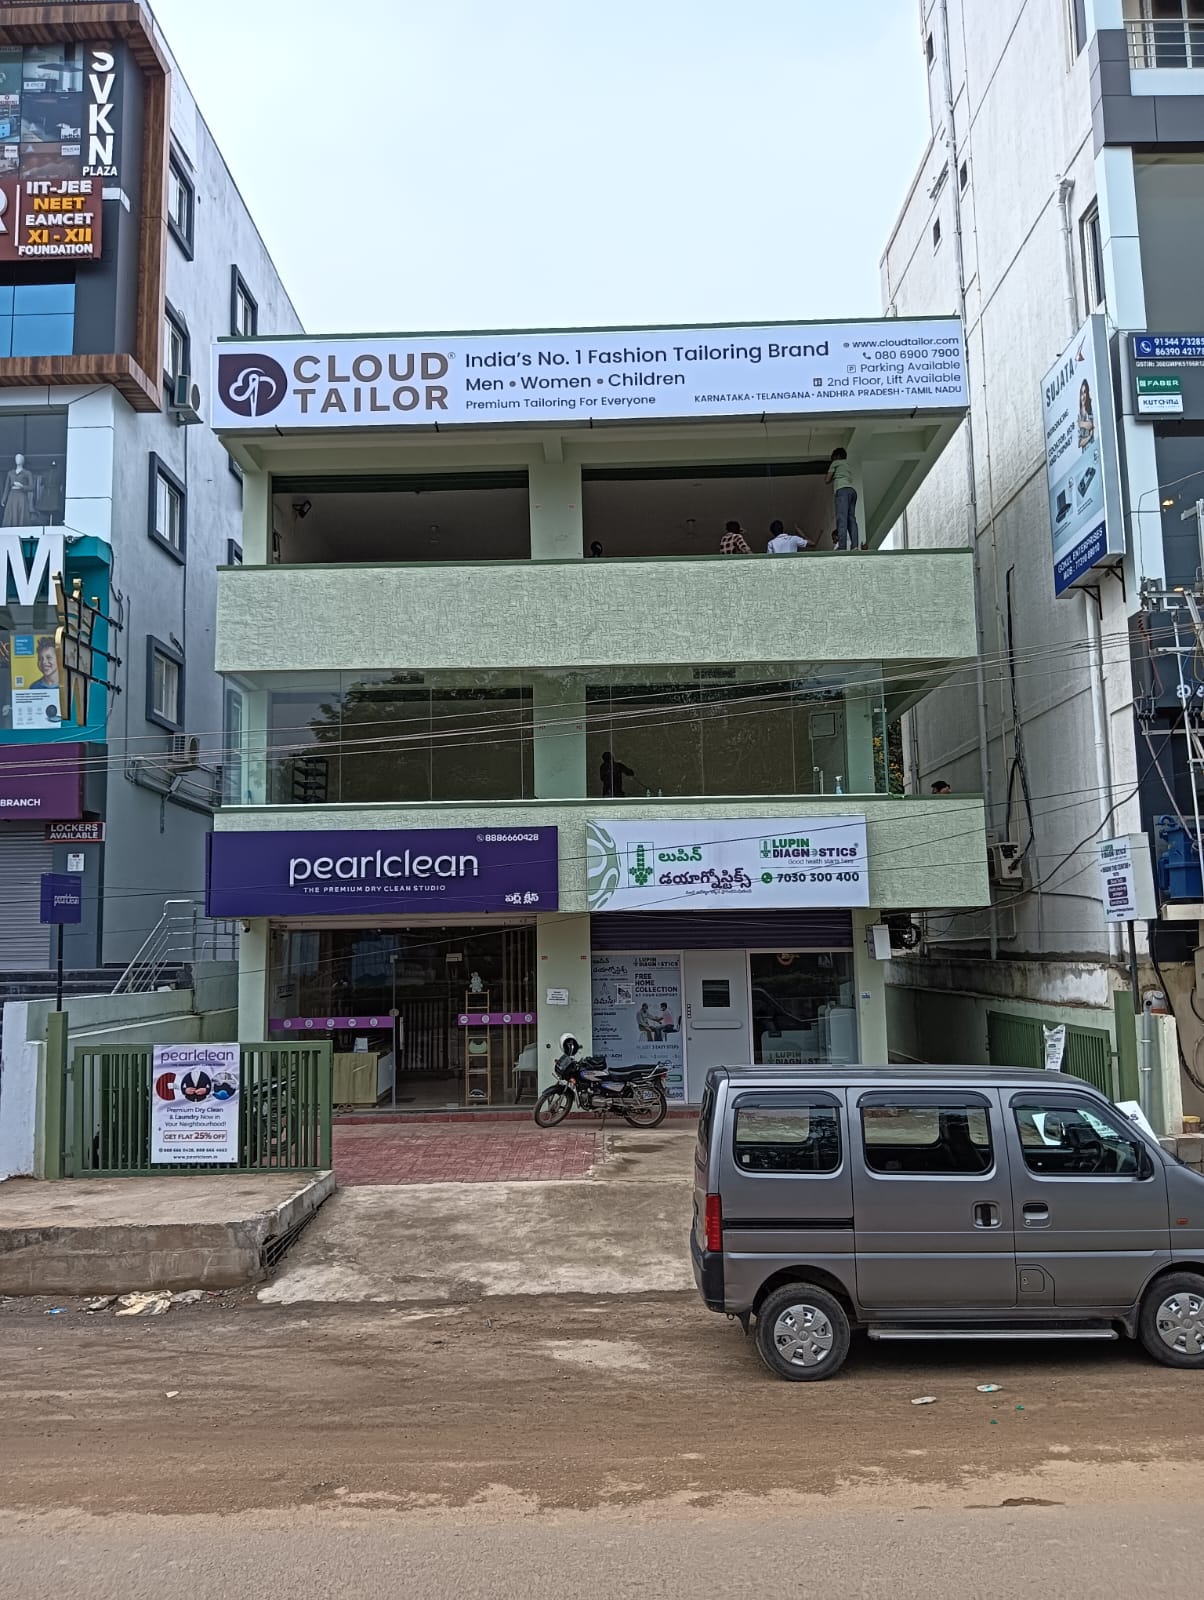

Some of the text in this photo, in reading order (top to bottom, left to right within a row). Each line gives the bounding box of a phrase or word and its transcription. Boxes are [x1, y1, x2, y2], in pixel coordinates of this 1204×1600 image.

[82, 165, 118, 177] PLAZA
[26, 180, 93, 195] IIT-JEE
[33, 196, 86, 211] NEET
[25, 212, 94, 226] EAMCET
[28, 229, 49, 243] XI
[64, 228, 92, 243] XII
[18, 243, 93, 256] FOUNDATION
[852, 336, 960, 349] www.cloudtailor.com
[1153, 337, 1179, 346] 91544
[538, 351, 570, 367] No.
[575, 349, 582, 365] 1
[588, 346, 667, 364] Fashion
[672, 344, 763, 364] Tailoring
[768, 340, 830, 358] Brand
[874, 348, 961, 361] 080 6900 7900
[1155, 348, 1180, 356] 86390
[293, 352, 449, 384] CLOUD
[860, 360, 961, 374] Parking Available
[465, 371, 686, 391] Men Women Children
[827, 373, 962, 388] 2nd Floor, Lift Available
[1045, 358, 1075, 408] SUJATA
[293, 385, 449, 414] TAILOR
[694, 385, 962, 403] KARNATAKA TELANGANA ANDHRA PRADESH TAMIL NADU
[465, 394, 657, 410] Premium Tailoring For Everyone
[0, 798, 41, 807] BRANCH
[50, 823, 98, 832] LOCKERS
[49, 831, 98, 840] AVAILABLE
[485, 833, 539, 842] 8886660428
[772, 838, 810, 849] LUPIN
[658, 846, 703, 862] లుపిన్
[288, 849, 479, 887] pearlclean
[777, 871, 860, 883] 7030 300 400
[364, 885, 382, 893] DRY
[413, 884, 447, 892] STUDIO
[160, 1049, 234, 1064] pearlclean
[194, 1132, 213, 1140] 25%
